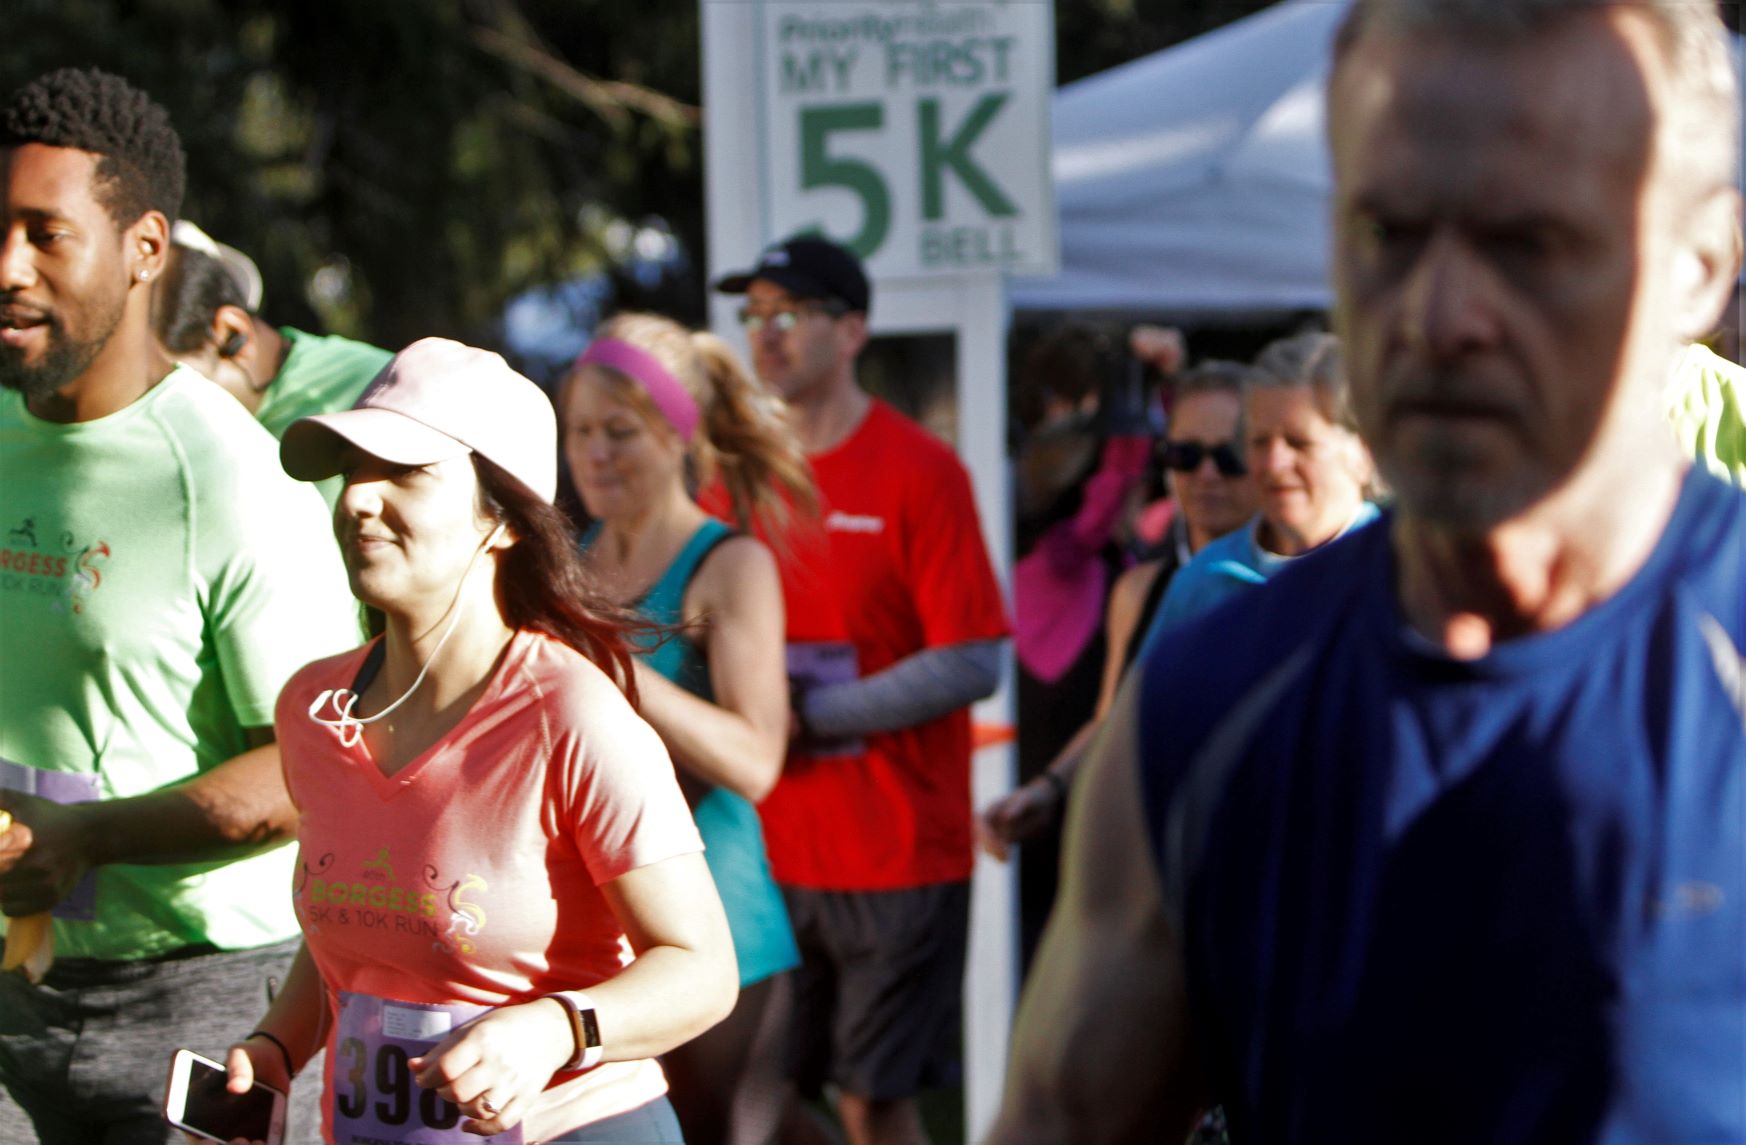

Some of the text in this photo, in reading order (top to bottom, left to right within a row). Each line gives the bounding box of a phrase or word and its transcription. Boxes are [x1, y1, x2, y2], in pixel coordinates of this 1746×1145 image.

[779, 36, 1016, 93] MY FIRST
[919, 226, 1019, 266] BELL
[0, 548, 67, 577] RGESS
[311, 881, 436, 917] BORGESS
[310, 905, 438, 937] 5K & 10K RUN
